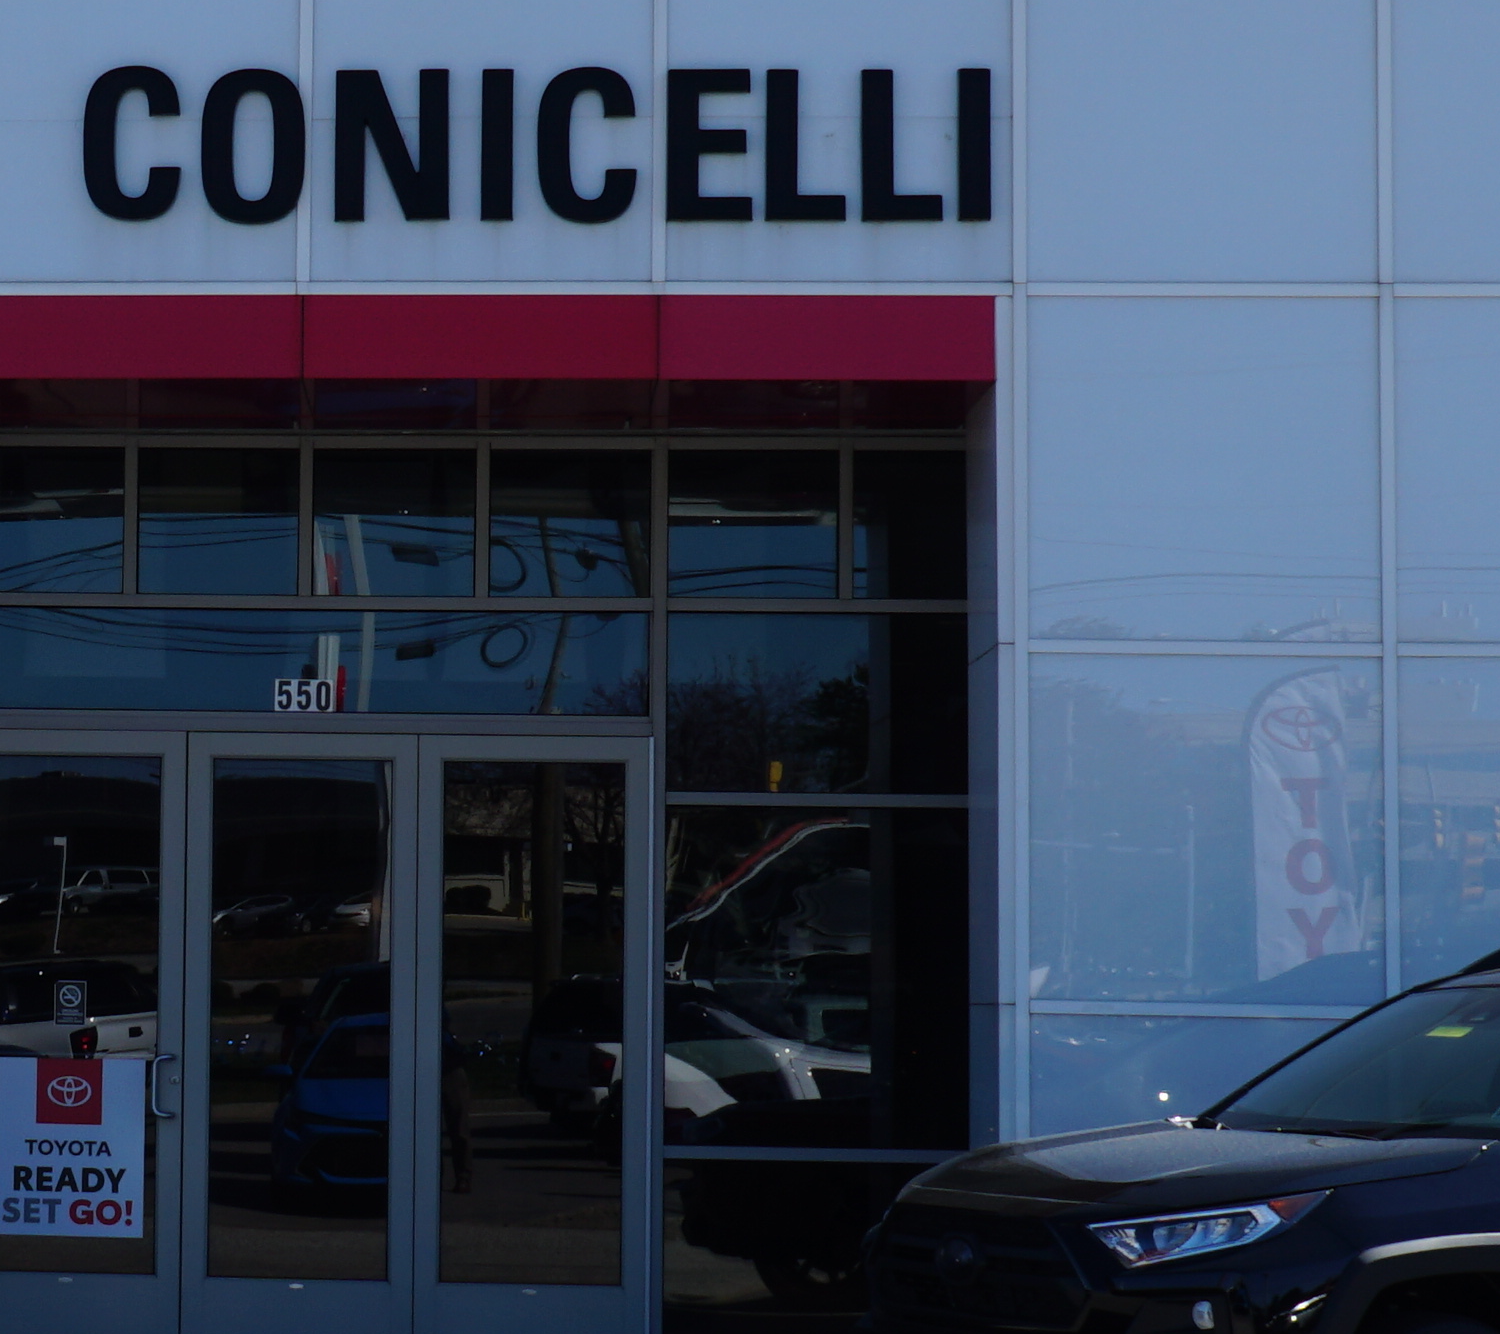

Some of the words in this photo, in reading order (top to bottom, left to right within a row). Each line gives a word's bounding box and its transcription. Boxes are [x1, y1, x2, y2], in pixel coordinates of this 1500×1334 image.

[82, 65, 991, 224] CONICELLI
[277, 680, 331, 711] 550
[24, 1139, 112, 1157] TOYOTA
[13, 1165, 126, 1193] READY
[2, 1197, 62, 1224] SET
[68, 1199, 133, 1226] GO!
